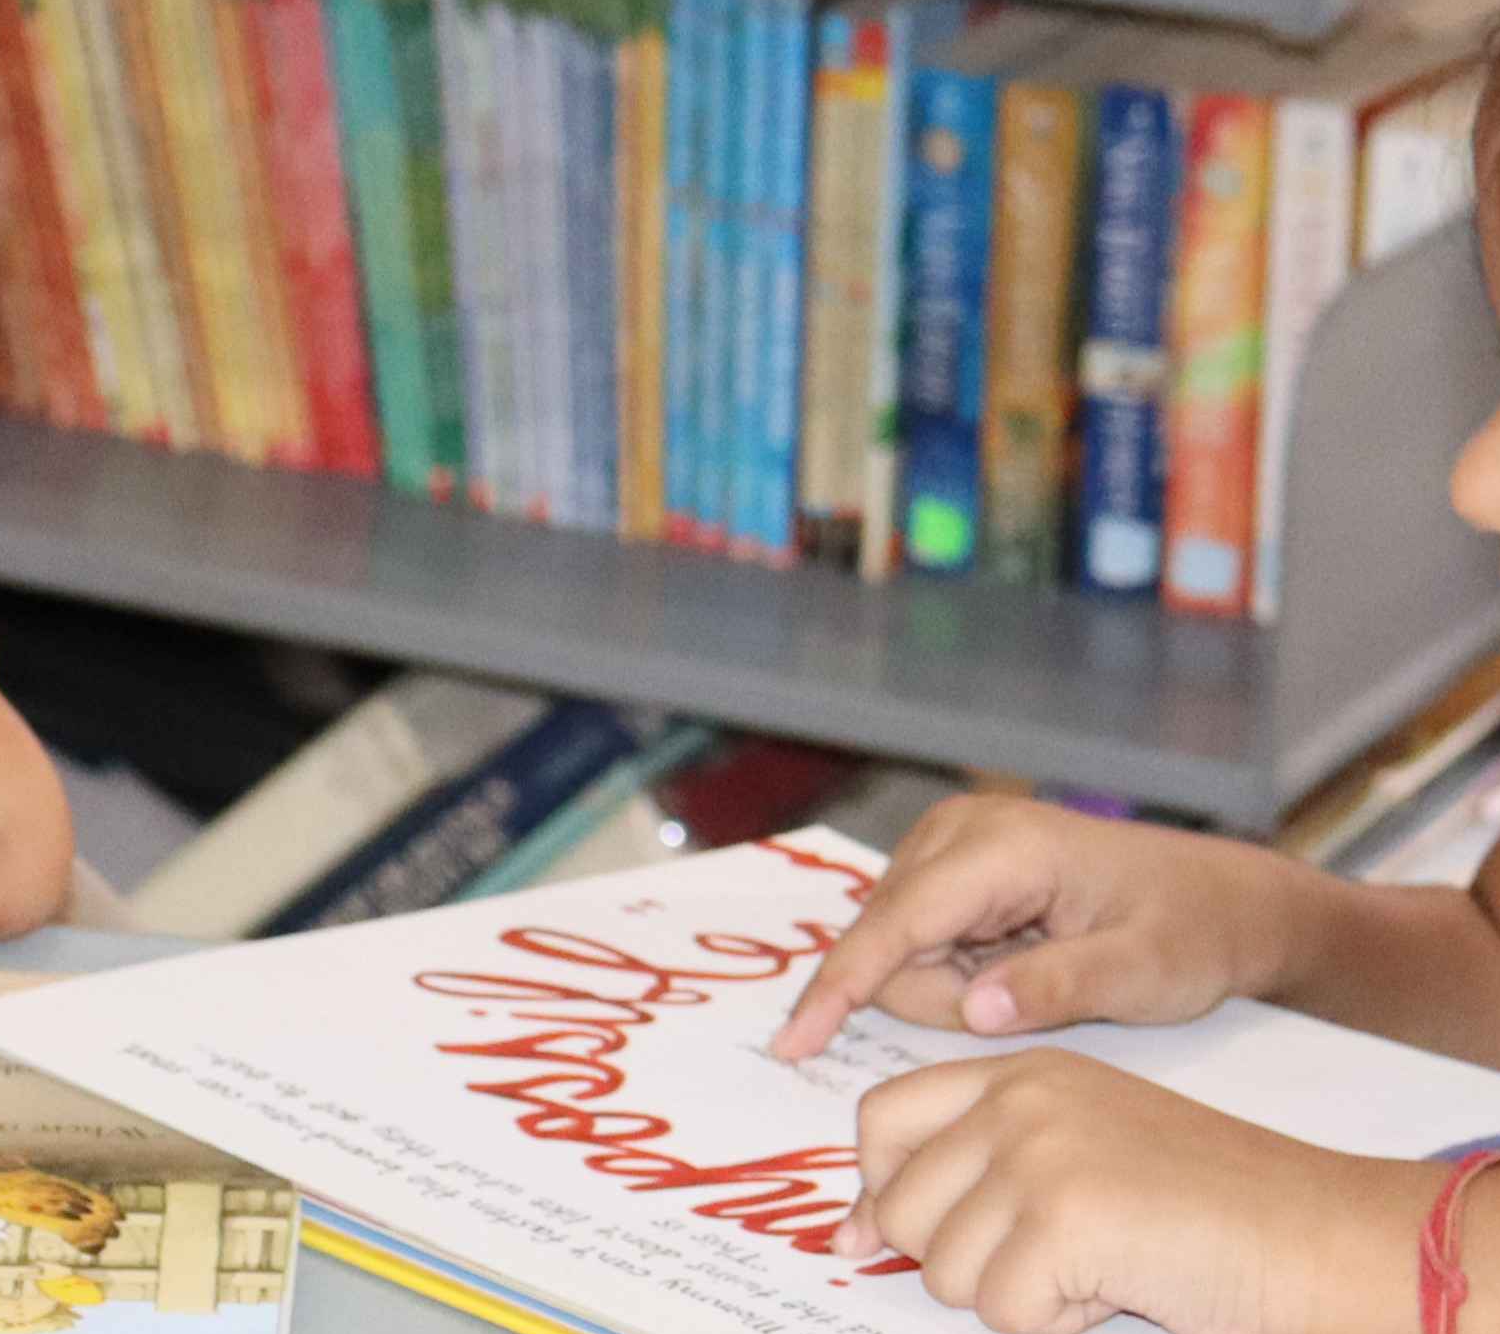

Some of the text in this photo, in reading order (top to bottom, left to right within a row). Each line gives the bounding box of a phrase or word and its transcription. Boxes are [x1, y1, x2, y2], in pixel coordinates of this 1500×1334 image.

[405, 1174, 458, 1199] the
[433, 1159, 525, 1196] what
[468, 1197, 570, 1245] fasten
[529, 1196, 592, 1225] like
[685, 1261, 780, 1299] twins
[780, 1297, 837, 1326] the
